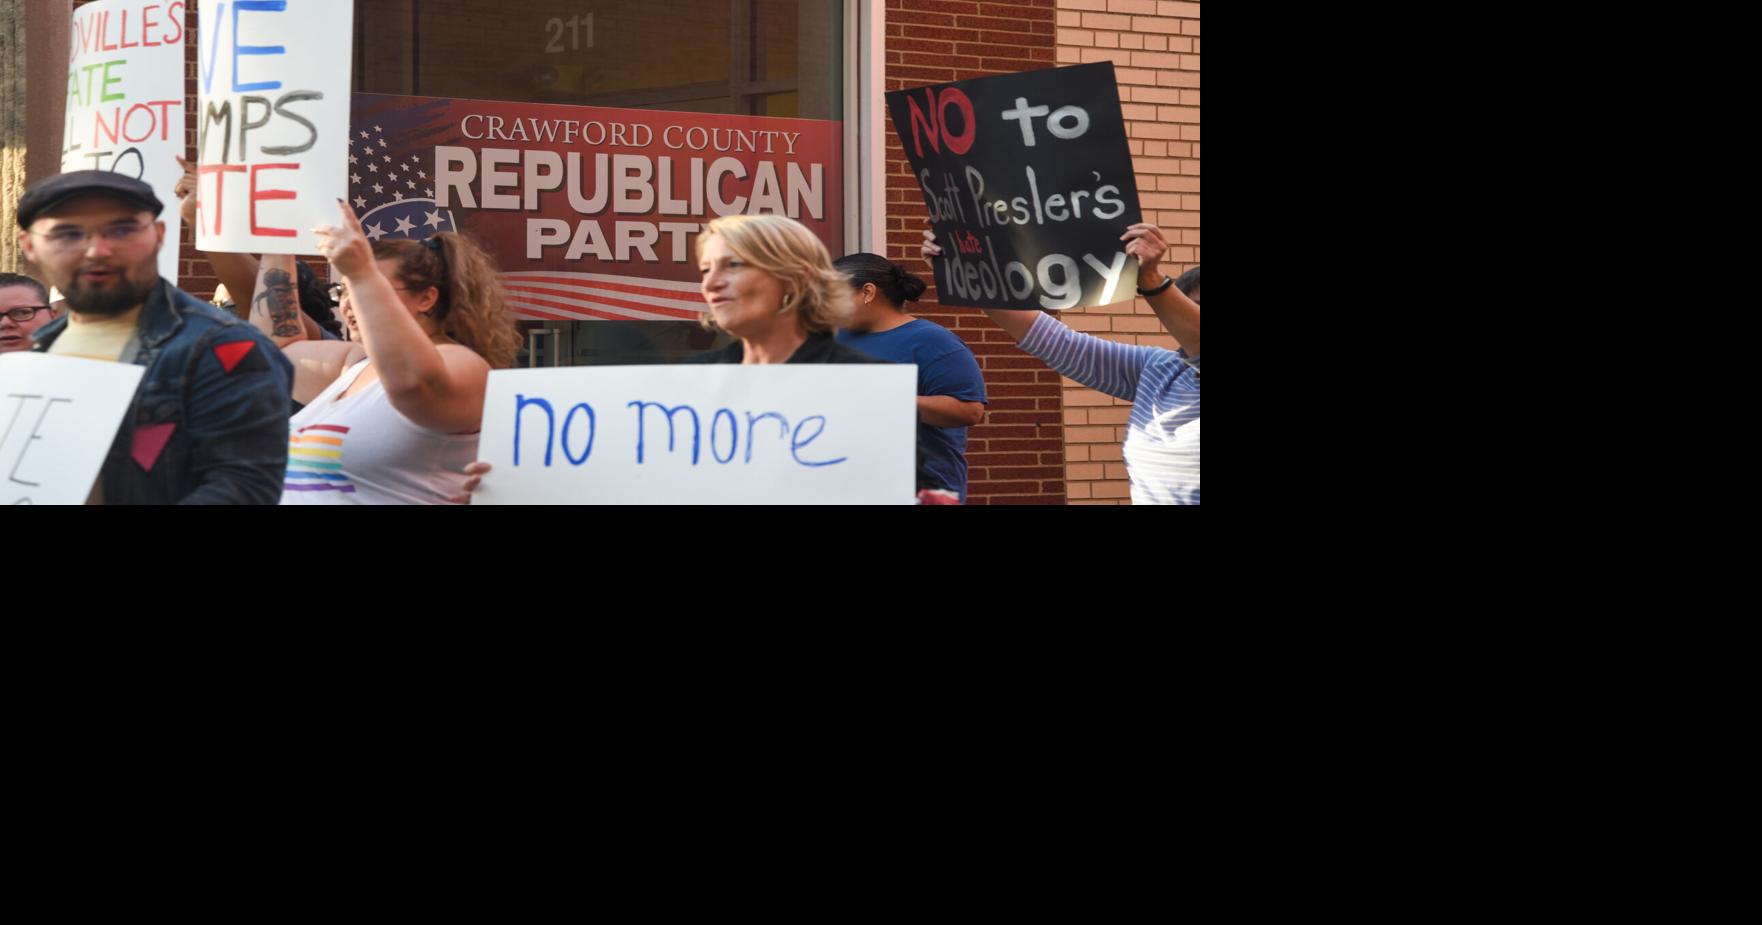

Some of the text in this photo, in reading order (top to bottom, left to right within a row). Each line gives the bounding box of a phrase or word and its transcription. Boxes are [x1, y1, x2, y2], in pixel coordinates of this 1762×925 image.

[545, 12, 594, 53] 211
[94, 101, 181, 148] NOT
[461, 114, 801, 154] CRAWFORD COUNTY
[907, 87, 1090, 158] NO to
[434, 145, 824, 219] REPUBLICAN
[920, 165, 1126, 228] Scott Presler's
[526, 218, 712, 262] PART
[955, 231, 983, 254] hate
[942, 232, 1126, 310] ideology
[513, 394, 848, 467] no more
